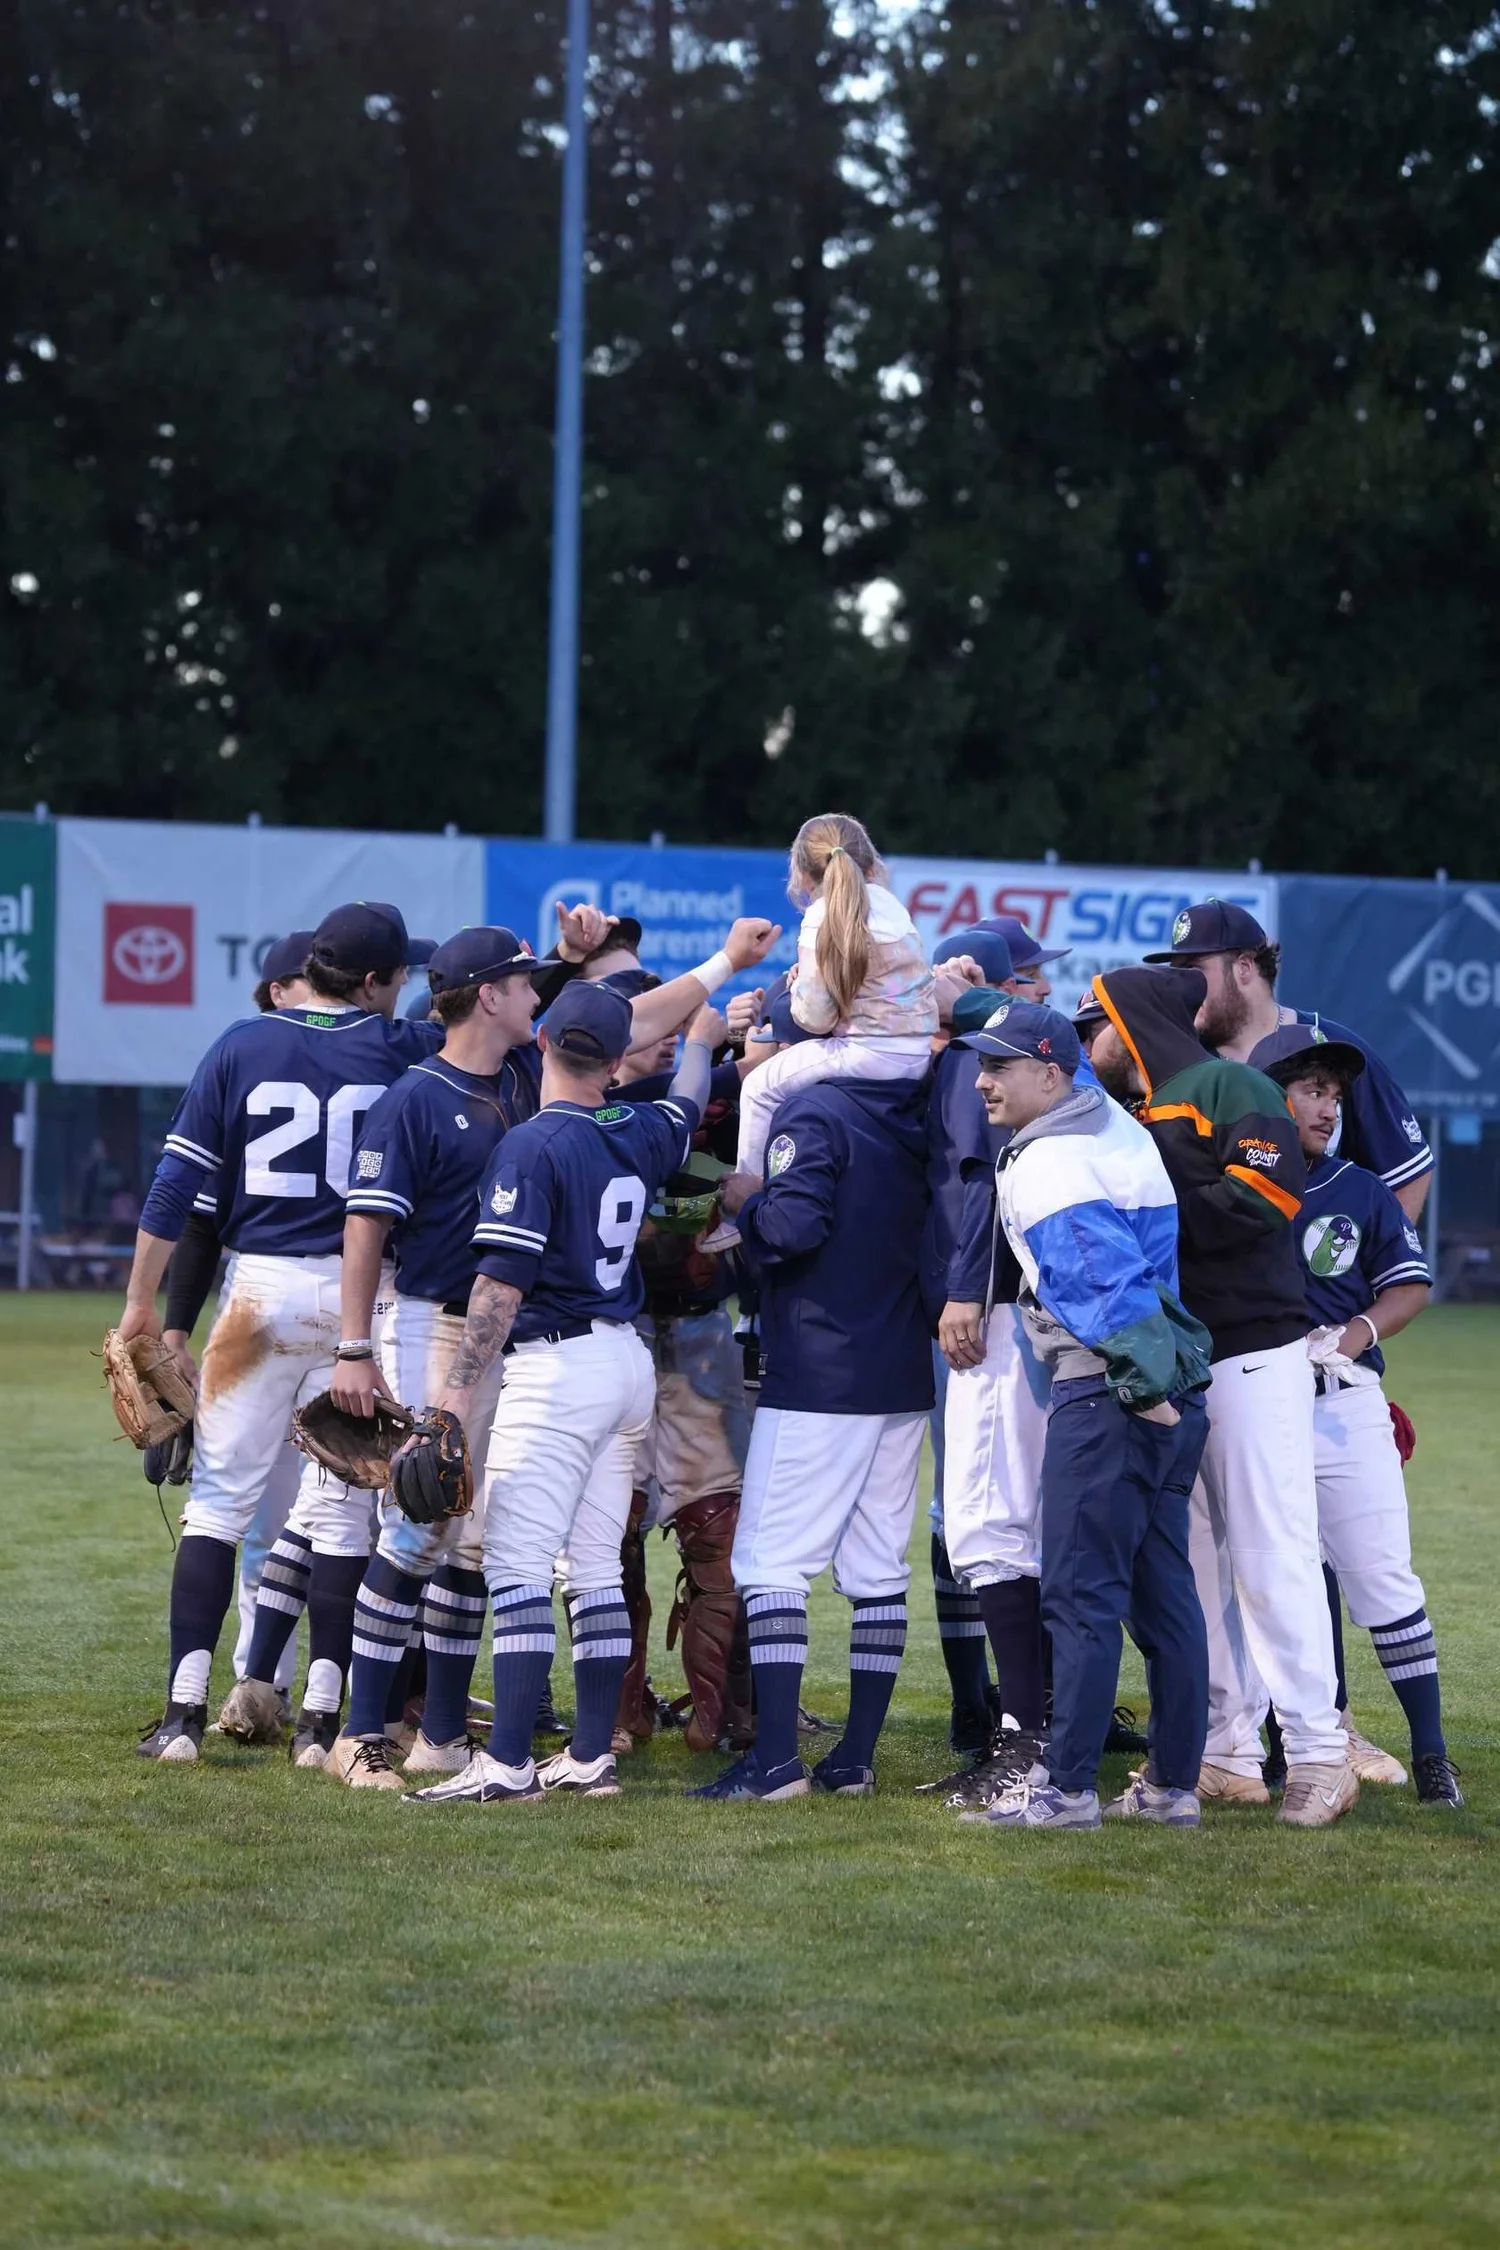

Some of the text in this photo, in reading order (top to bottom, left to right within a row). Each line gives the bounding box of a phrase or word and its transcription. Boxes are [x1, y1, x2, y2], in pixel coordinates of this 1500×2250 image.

[611, 879, 744, 921] Planned
[906, 883, 1259, 944] FASTSIG
[1424, 958, 1500, 1006] PG
[245, 1082, 388, 1198] 20
[1246, 1148, 1282, 1167] COUNTY
[596, 1175, 646, 1290] 9
